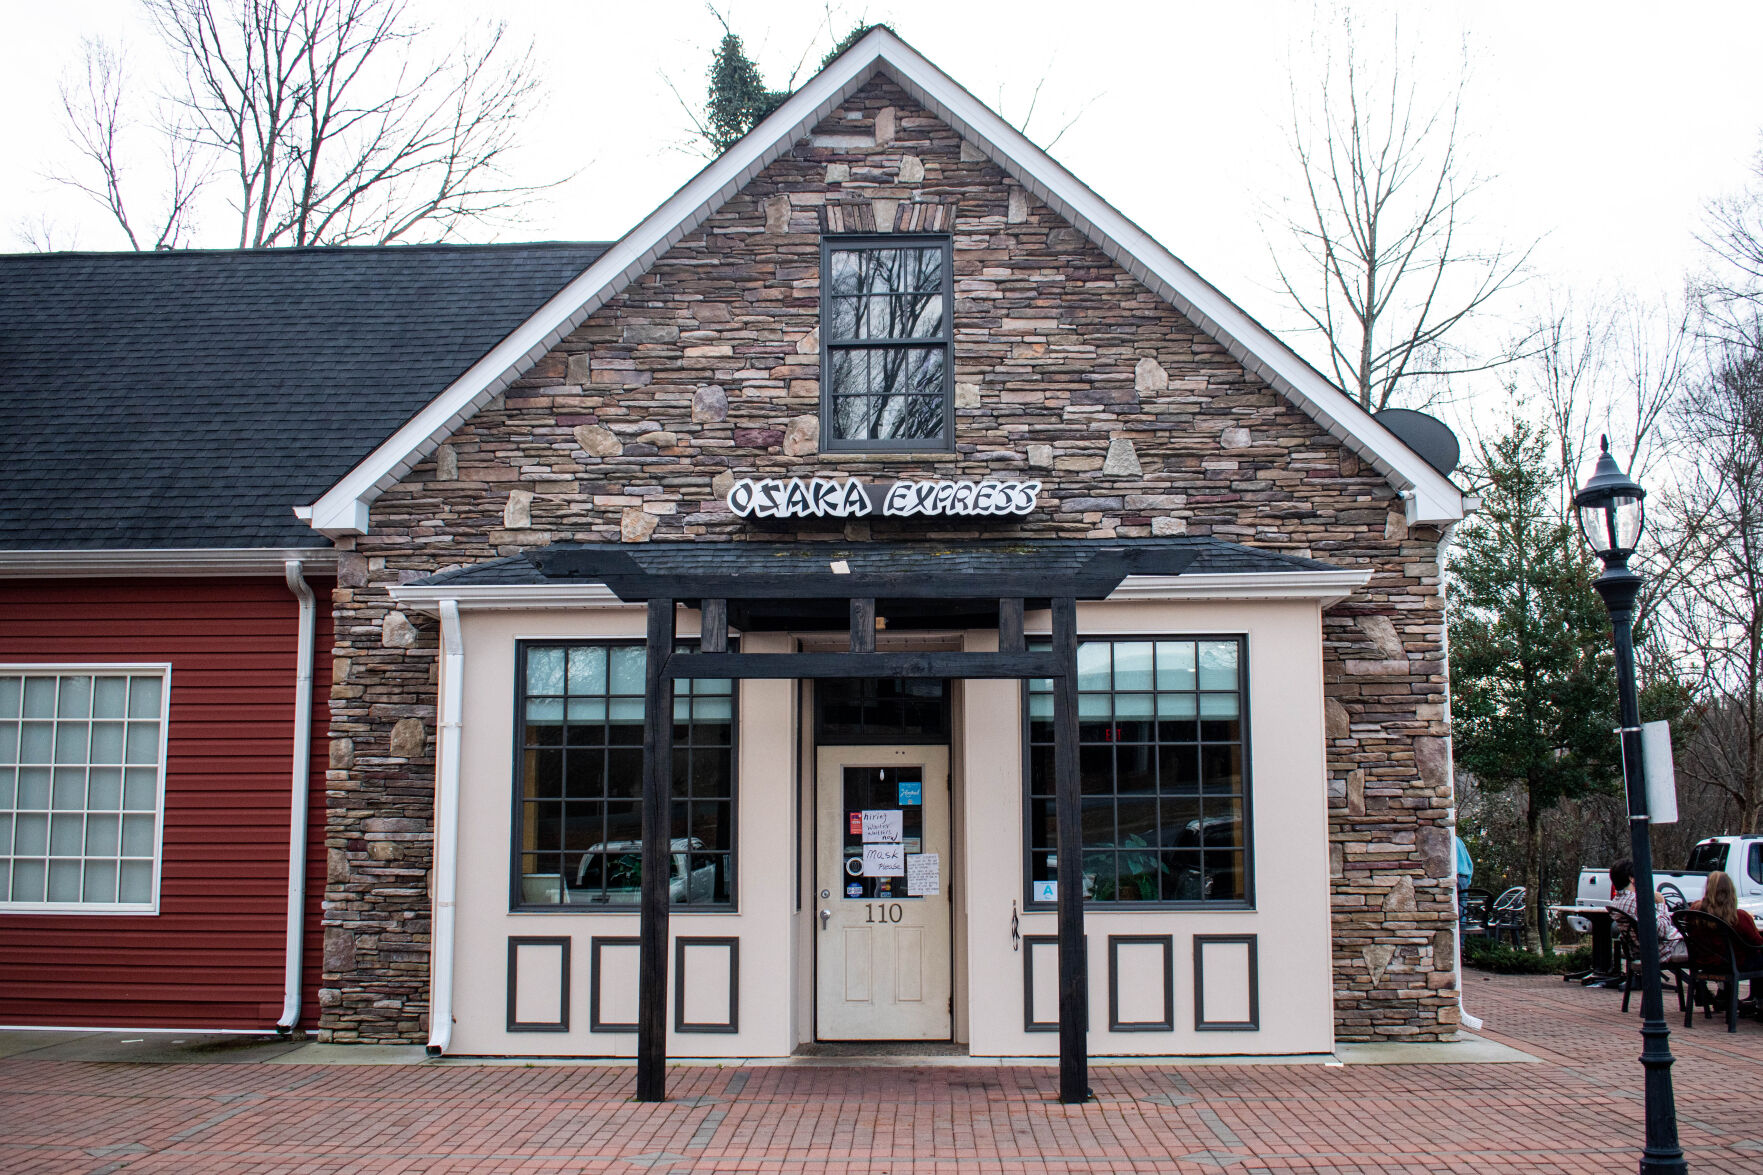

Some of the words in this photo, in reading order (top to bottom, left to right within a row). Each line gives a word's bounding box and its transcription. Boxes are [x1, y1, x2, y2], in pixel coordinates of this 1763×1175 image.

[728, 478, 871, 517] OSAKA
[884, 481, 1042, 515] EXPRESS
[1043, 885, 1054, 895] A
[865, 903, 903, 923] 110
